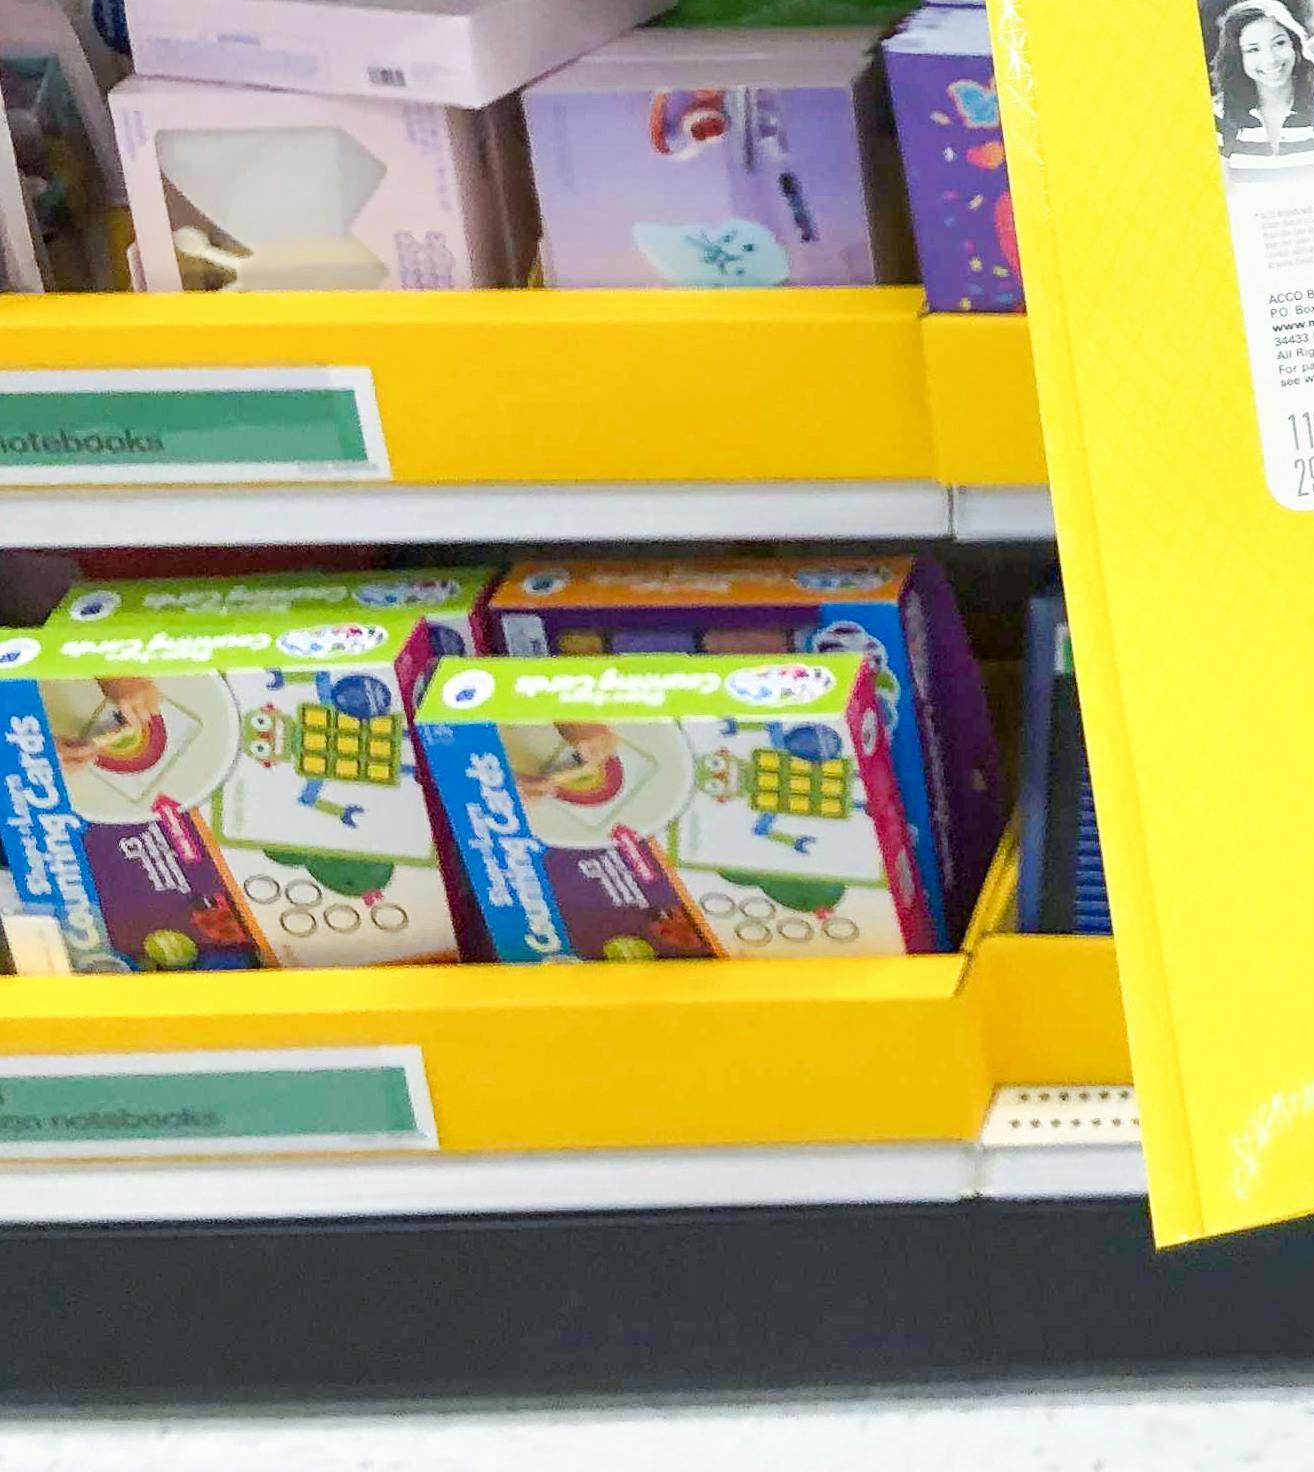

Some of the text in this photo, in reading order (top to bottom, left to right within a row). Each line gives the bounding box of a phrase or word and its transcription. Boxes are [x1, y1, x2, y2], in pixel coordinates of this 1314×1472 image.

[5, 714, 61, 809] Cards
[464, 751, 521, 836] Cards
[37, 810, 101, 951] Counting
[498, 835, 562, 955] Counting
